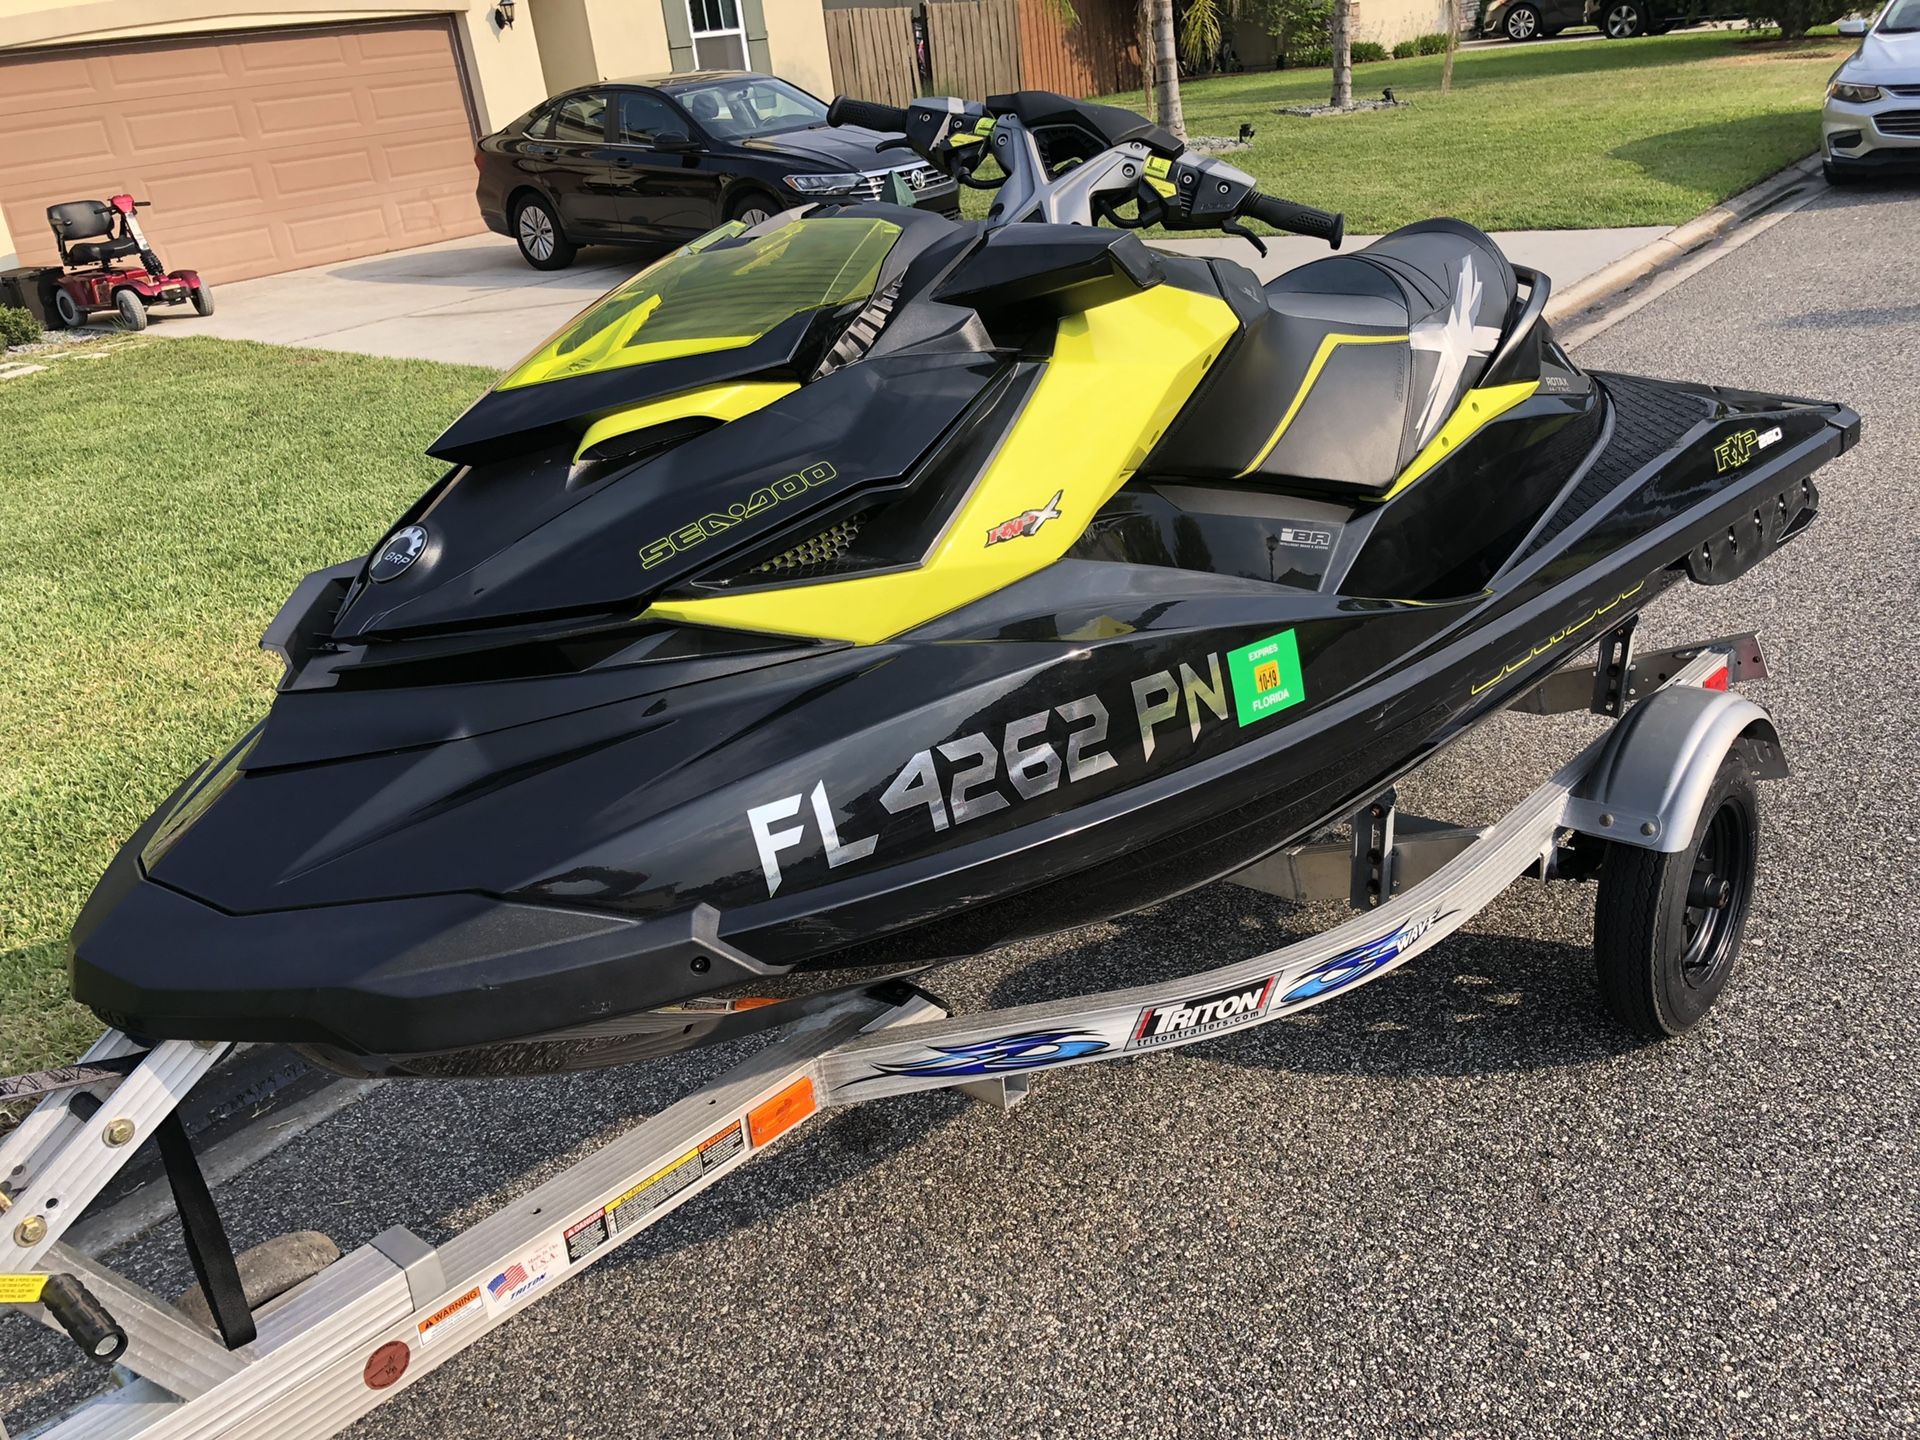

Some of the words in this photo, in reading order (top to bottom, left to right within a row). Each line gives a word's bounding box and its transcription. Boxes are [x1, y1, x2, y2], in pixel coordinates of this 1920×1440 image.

[384, 551, 411, 565] BRP
[1248, 643, 1279, 662] EXPIRES
[1259, 669, 1278, 692] 10-19
[1252, 688, 1290, 712] FLORIDA
[746, 779, 879, 898] FL
[879, 693, 1119, 832] 4262
[1130, 652, 1229, 764] PN
[1395, 914, 1438, 953] WAVE
[1153, 987, 1264, 1036] TRITON
[1136, 1009, 1260, 1047] tritontrailers.com
[510, 1272, 547, 1300] TRITON
[434, 1290, 478, 1322] WARNING
